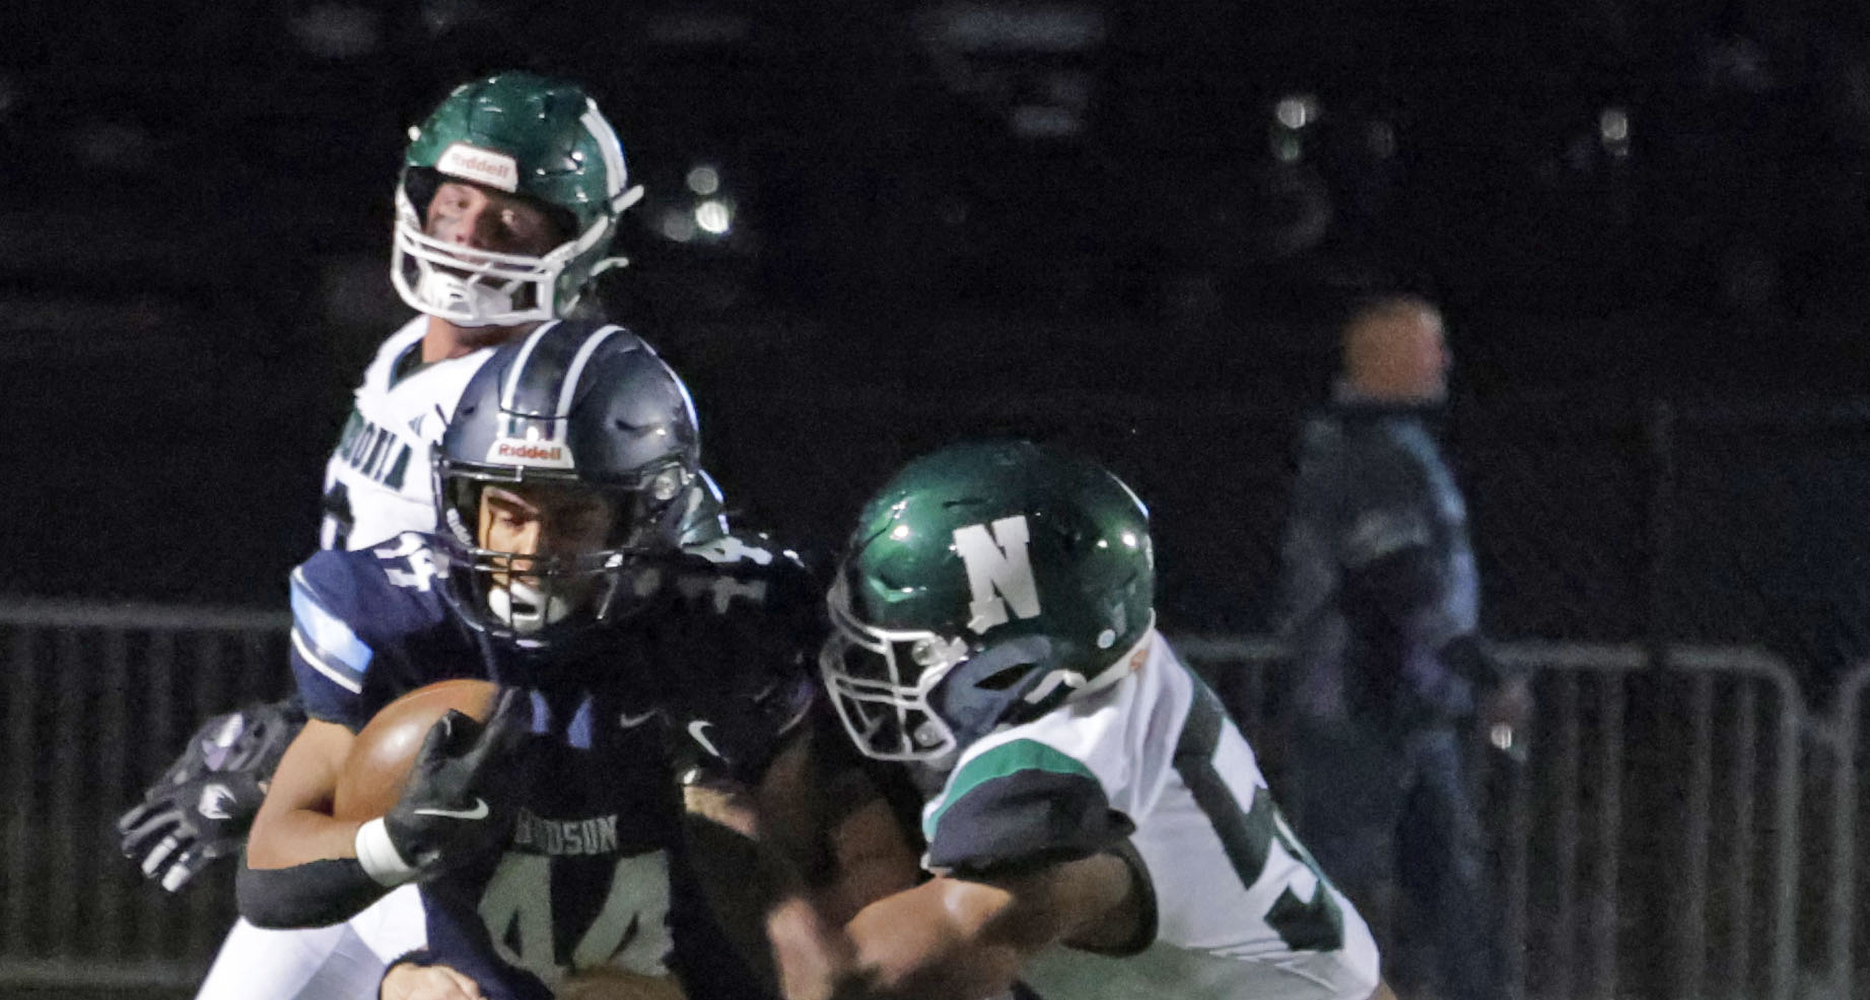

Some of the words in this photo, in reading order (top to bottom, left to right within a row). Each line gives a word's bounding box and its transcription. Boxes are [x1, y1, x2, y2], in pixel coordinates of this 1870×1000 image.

[499, 442, 563, 461] Riddell
[952, 514, 1042, 635] N
[476, 848, 675, 1000] 44
